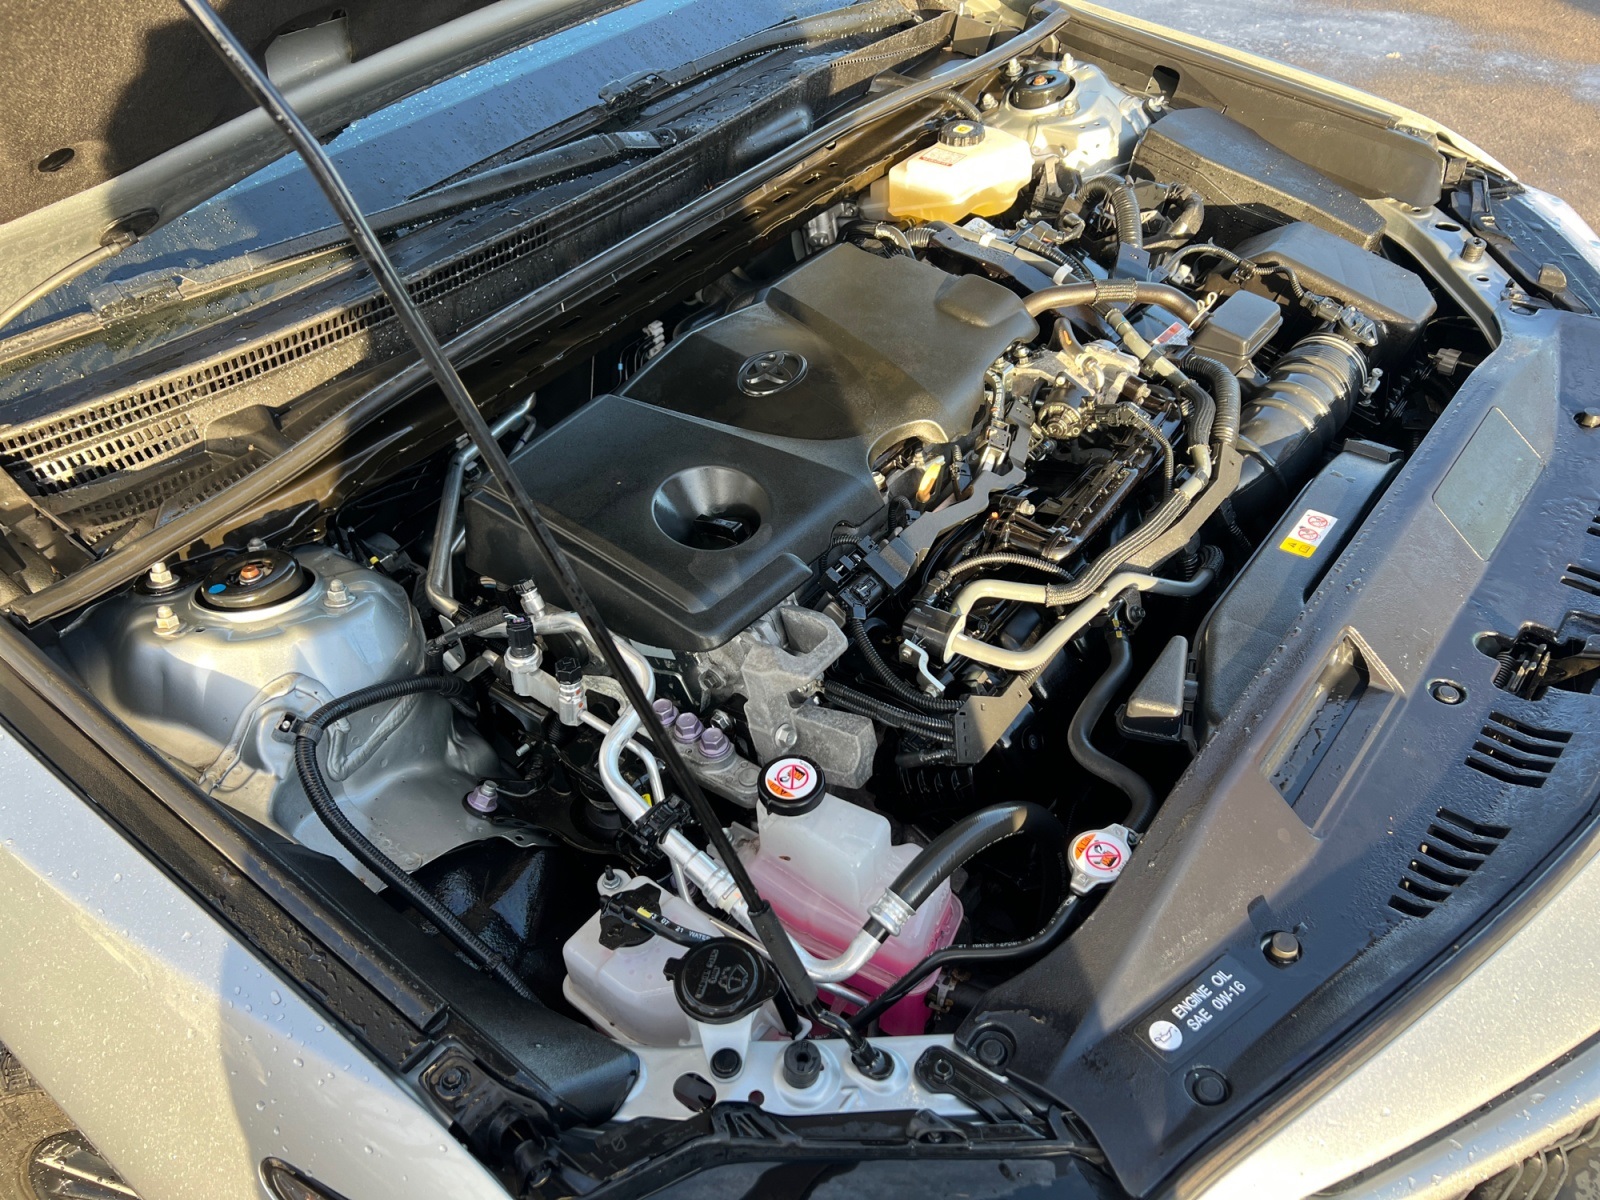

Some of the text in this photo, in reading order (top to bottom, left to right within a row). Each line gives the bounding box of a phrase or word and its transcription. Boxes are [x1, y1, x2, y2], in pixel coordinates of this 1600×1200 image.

[1171, 970, 1233, 1020] ENGINE OIL
[1187, 981, 1246, 1031] SAE 0W-16
